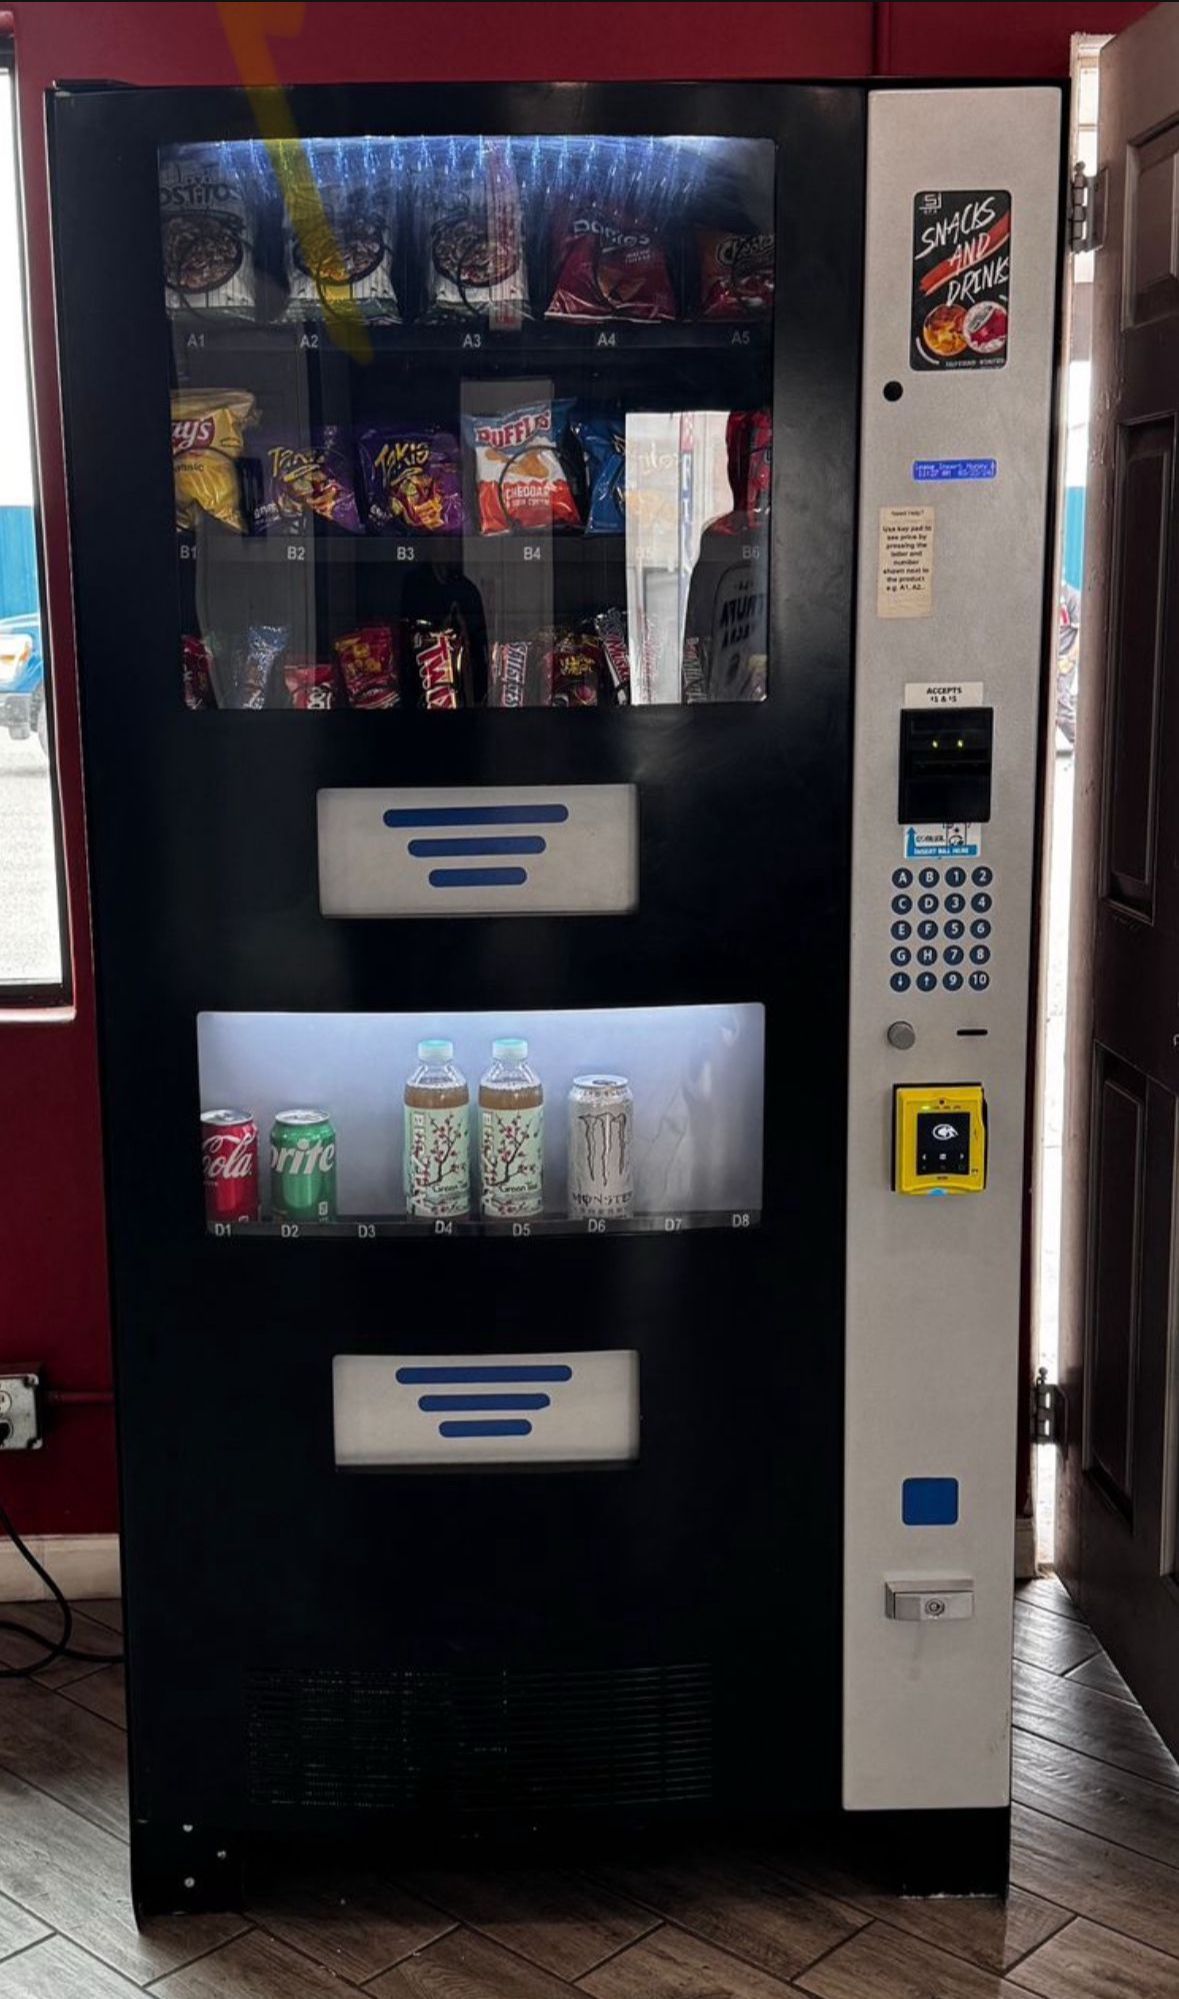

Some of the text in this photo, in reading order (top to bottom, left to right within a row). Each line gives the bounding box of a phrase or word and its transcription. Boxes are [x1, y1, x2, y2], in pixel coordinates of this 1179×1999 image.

[914, 196, 996, 260] SNACKS
[949, 232, 991, 275] AND
[946, 256, 1009, 307] DRINK
[186, 334, 205, 348] A1
[300, 334, 318, 348] A2
[462, 334, 481, 348] A3
[597, 333, 616, 346] A4
[731, 332, 750, 345] A5
[171, 422, 212, 449] ays
[287, 546, 305, 560] B2
[396, 546, 415, 560] B3
[523, 547, 541, 560] B4
[742, 545, 760, 559] B6
[926, 686, 962, 695] ACCEPTS
[899, 870, 986, 883] A B 1 2
[898, 896, 985, 909] C D 3 4
[898, 922, 984, 935] E F 5 6
[897, 948, 984, 961] G H 7 8
[949, 974, 987, 985] 9 10
[271, 1138, 335, 1174] rite
[499, 1184, 526, 1193] Green
[435, 1221, 453, 1234] D4
[588, 1219, 605, 1233] D6
[664, 1219, 682, 1231] D7
[732, 1214, 750, 1228] D8
[214, 1224, 232, 1237] D1
[281, 1225, 299, 1238] D2
[358, 1225, 376, 1238] D3
[512, 1223, 530, 1237] D5
